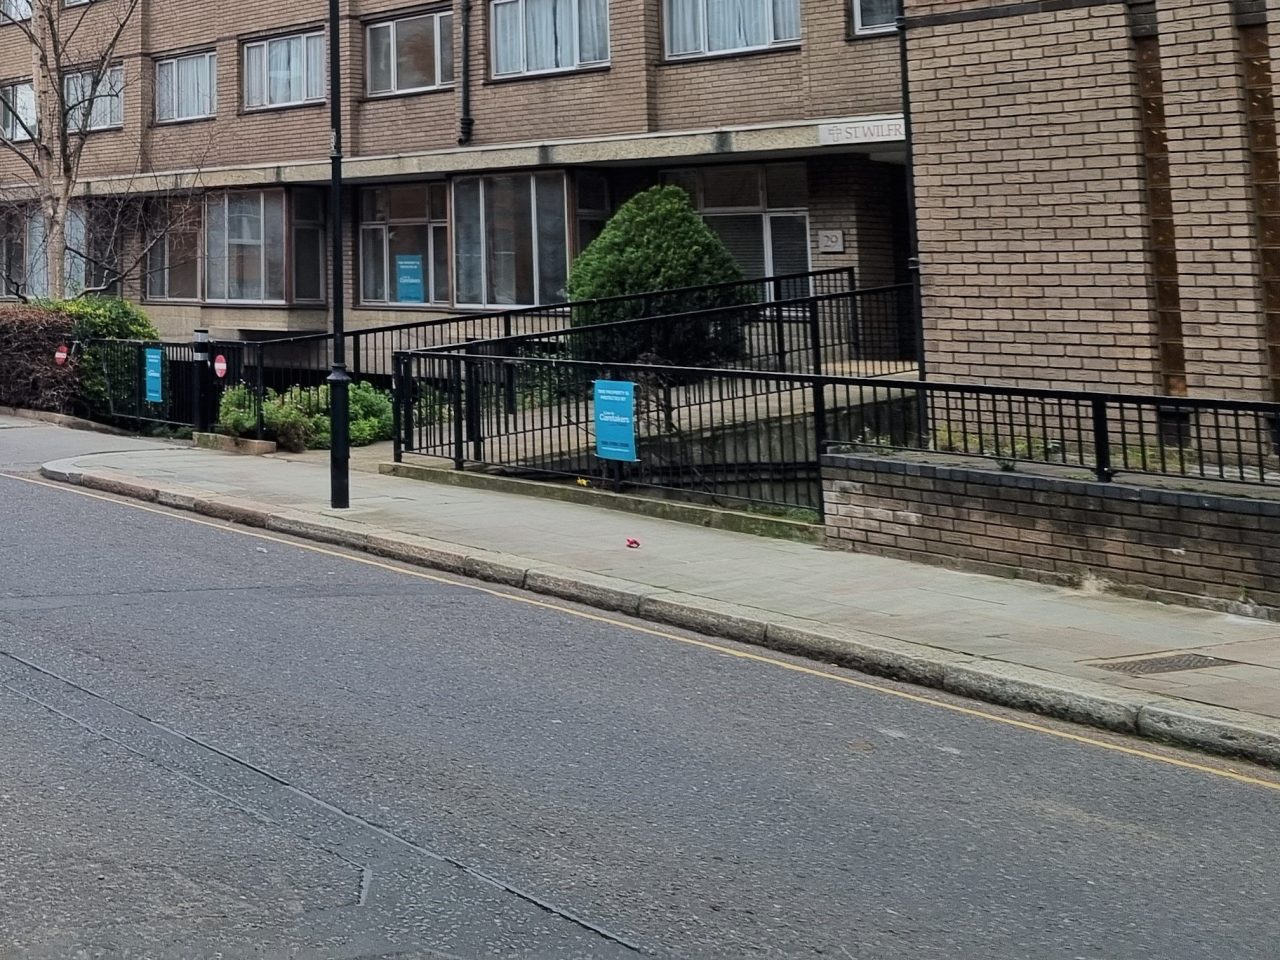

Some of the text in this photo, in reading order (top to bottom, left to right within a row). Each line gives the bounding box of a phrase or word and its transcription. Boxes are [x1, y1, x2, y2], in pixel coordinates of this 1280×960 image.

[844, 124, 903, 139] ST WILFR
[824, 235, 839, 248] 29
